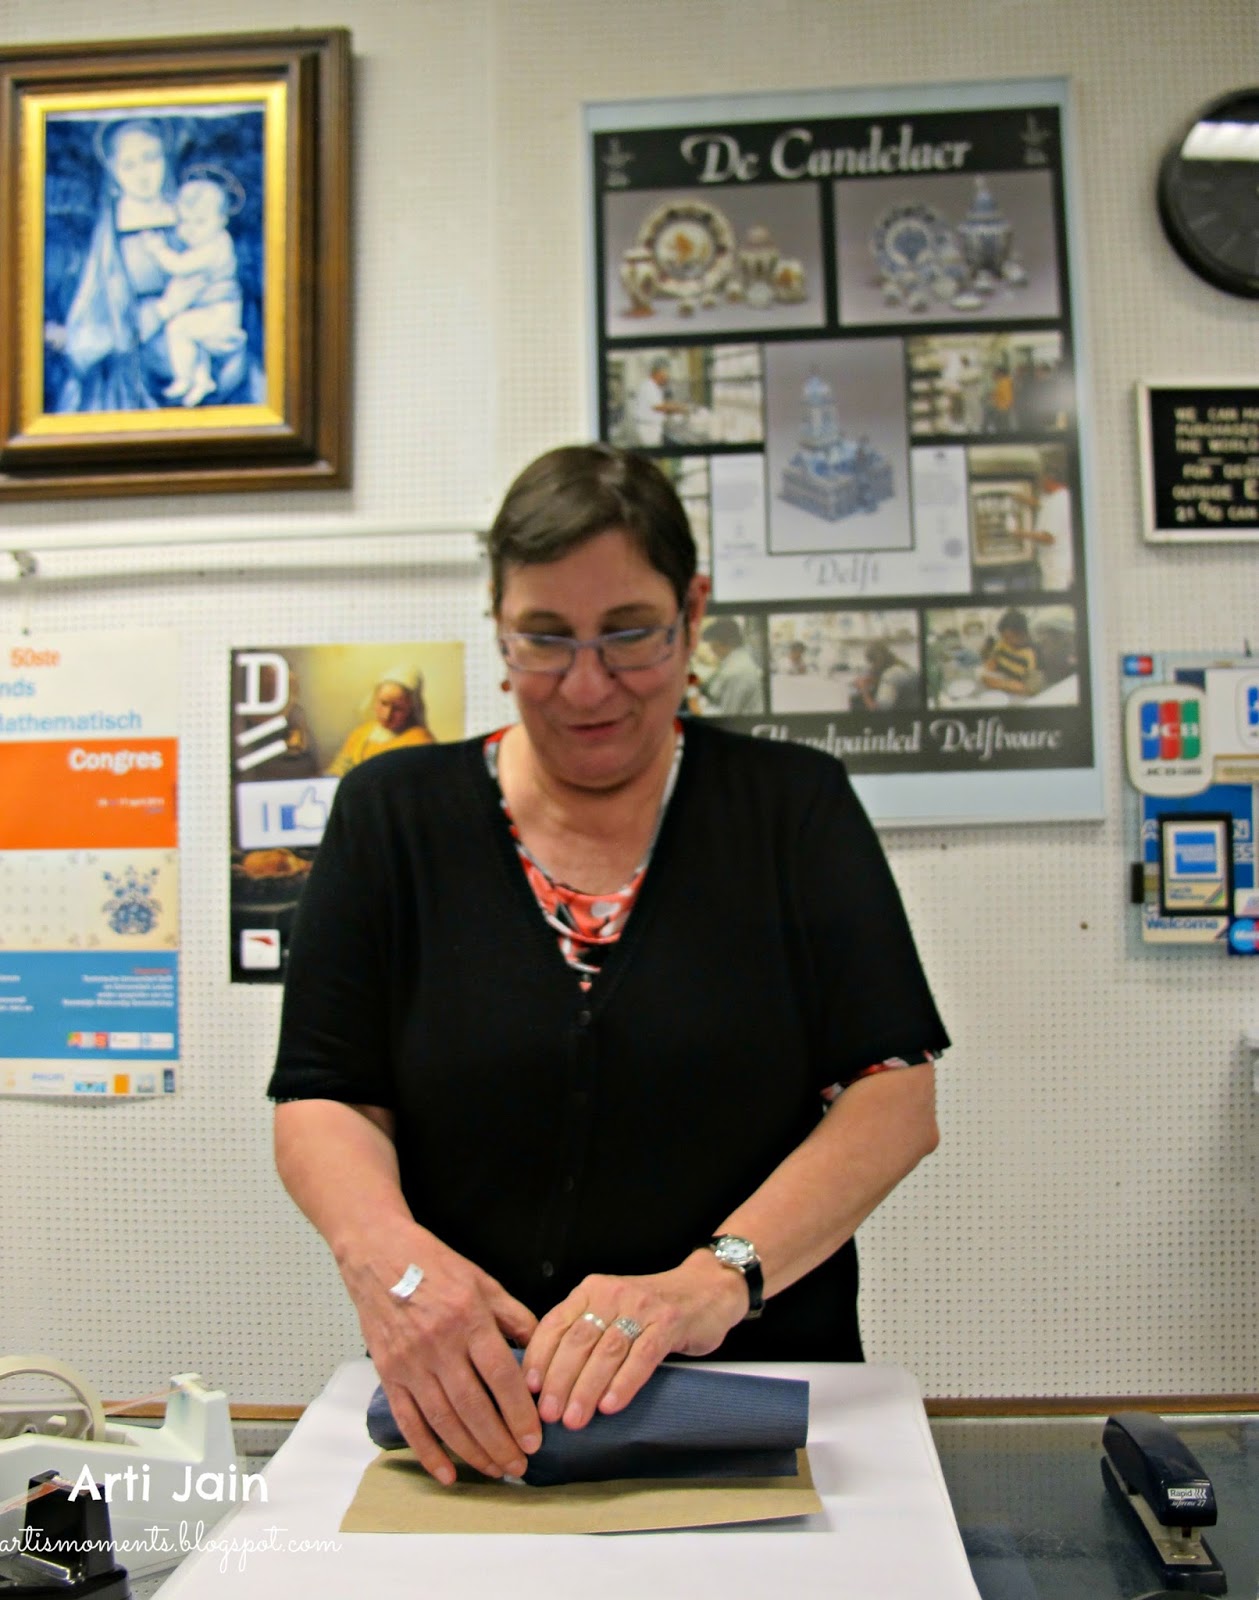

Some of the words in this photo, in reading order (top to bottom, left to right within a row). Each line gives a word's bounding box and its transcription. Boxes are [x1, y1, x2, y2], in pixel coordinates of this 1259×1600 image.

[681, 134, 759, 183] De
[0, 709, 142, 734] athematisch
[1142, 722, 1199, 738] JCB
[929, 716, 1064, 761] Delftware
[68, 748, 164, 775] Congres
[1171, 1490, 1192, 1498] Rapid
